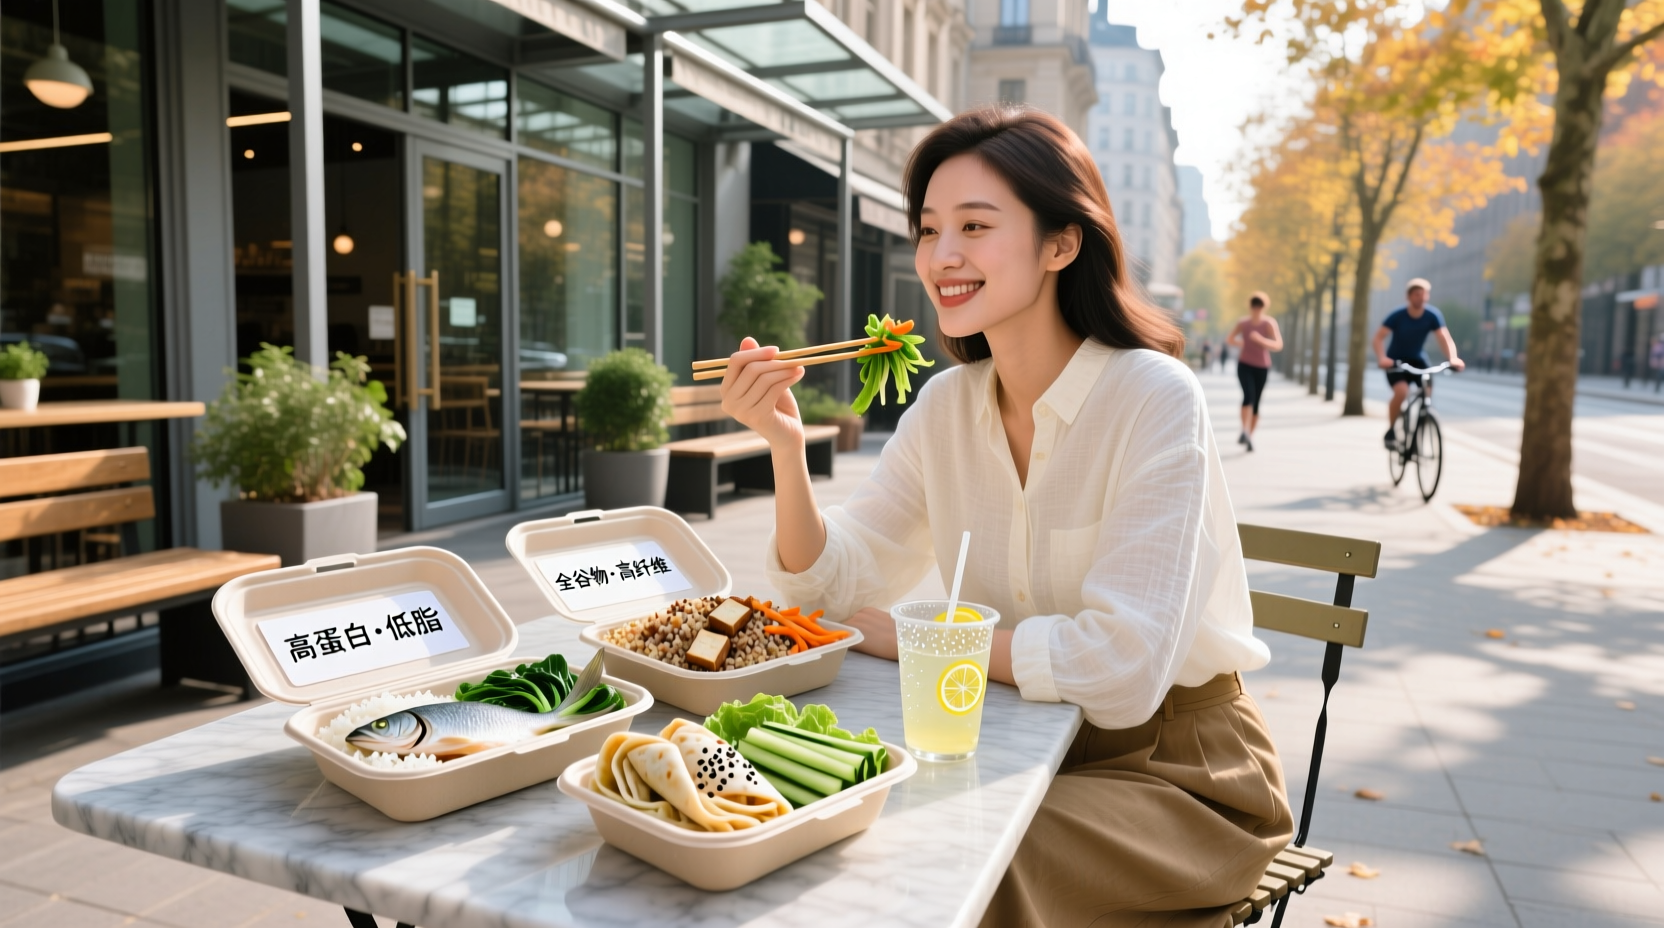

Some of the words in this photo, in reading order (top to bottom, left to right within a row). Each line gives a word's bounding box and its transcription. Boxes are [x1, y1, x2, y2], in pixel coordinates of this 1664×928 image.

[284, 606, 443, 663] 高蛋白·低脂
